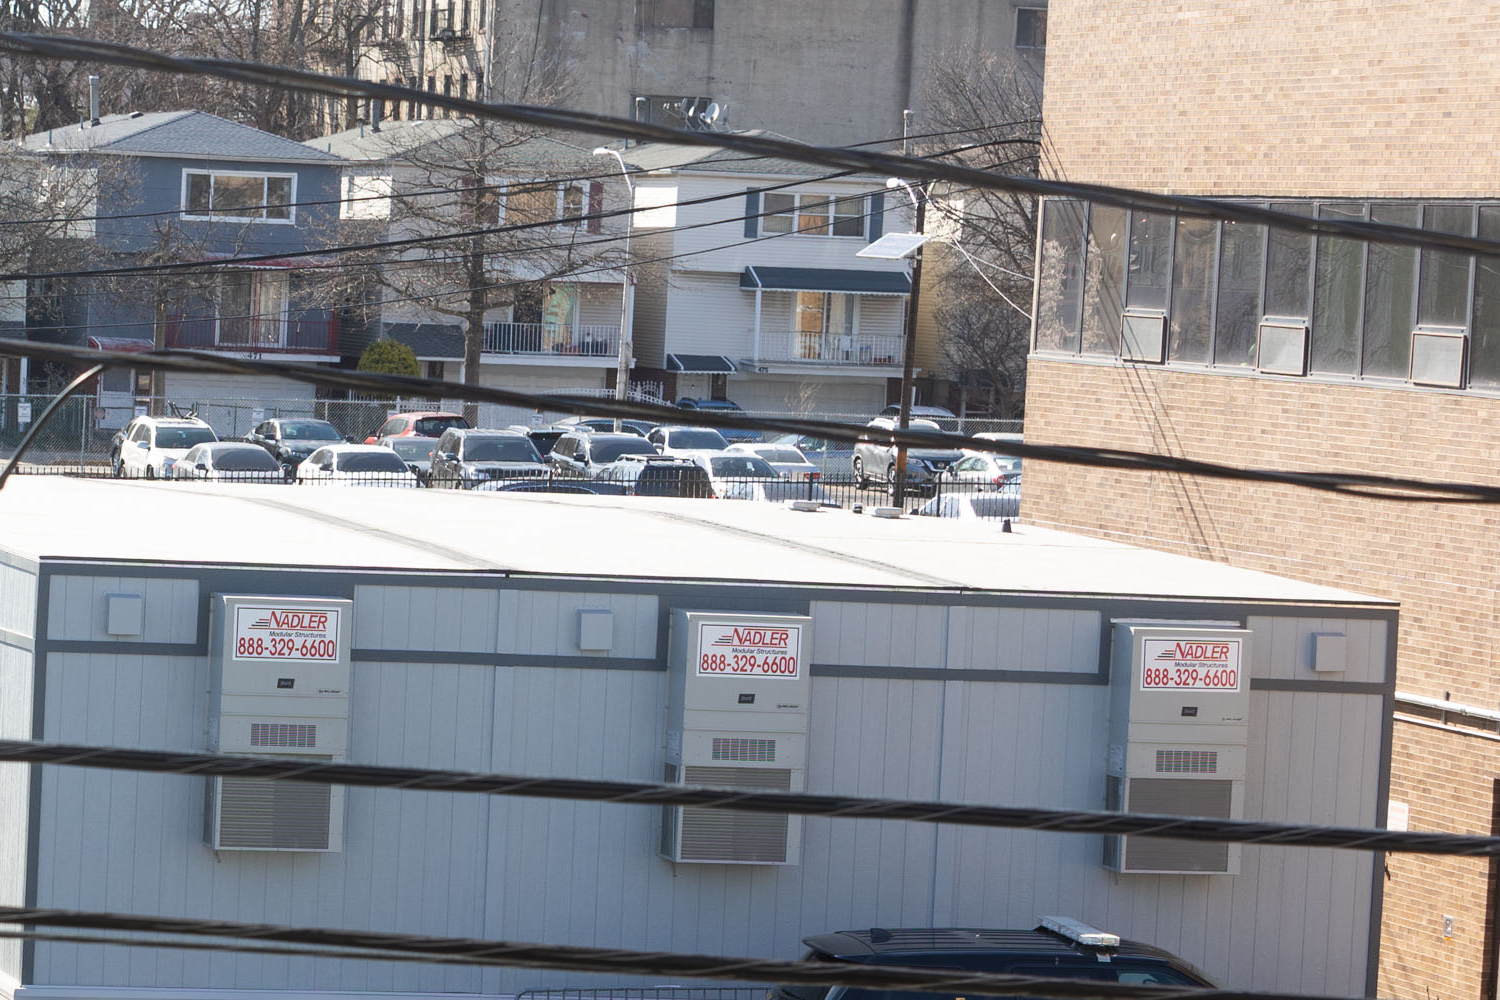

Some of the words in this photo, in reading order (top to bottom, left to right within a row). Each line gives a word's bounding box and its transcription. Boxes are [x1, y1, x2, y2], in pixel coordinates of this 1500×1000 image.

[268, 611, 328, 629] NADLER
[294, 631, 326, 639] Structures
[730, 628, 789, 645] NADLER
[238, 636, 335, 656] 888-329-6600
[1173, 642, 1229, 660] NADLER
[701, 653, 796, 673] 888-329-6600
[1145, 667, 1237, 688] 888-329-6600
